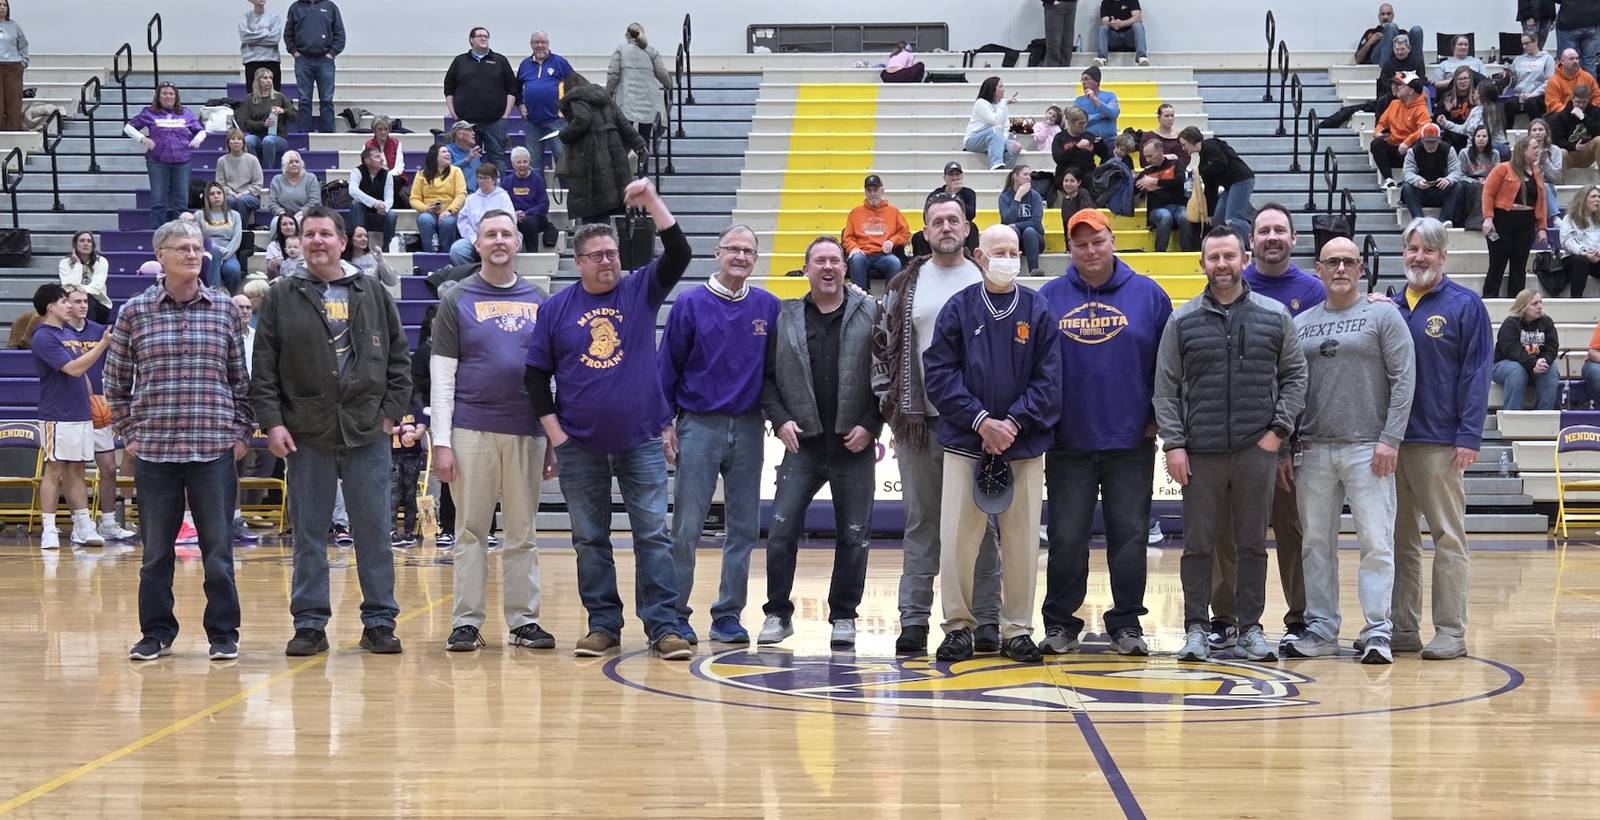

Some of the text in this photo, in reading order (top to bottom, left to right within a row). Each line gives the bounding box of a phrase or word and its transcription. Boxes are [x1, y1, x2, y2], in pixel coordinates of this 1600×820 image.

[577, 307, 624, 327] MENDOA
[1059, 315, 1129, 330] MENDOTA
[1080, 328, 1105, 336] FOOTBALL
[1299, 318, 1367, 340] NEXT STEP
